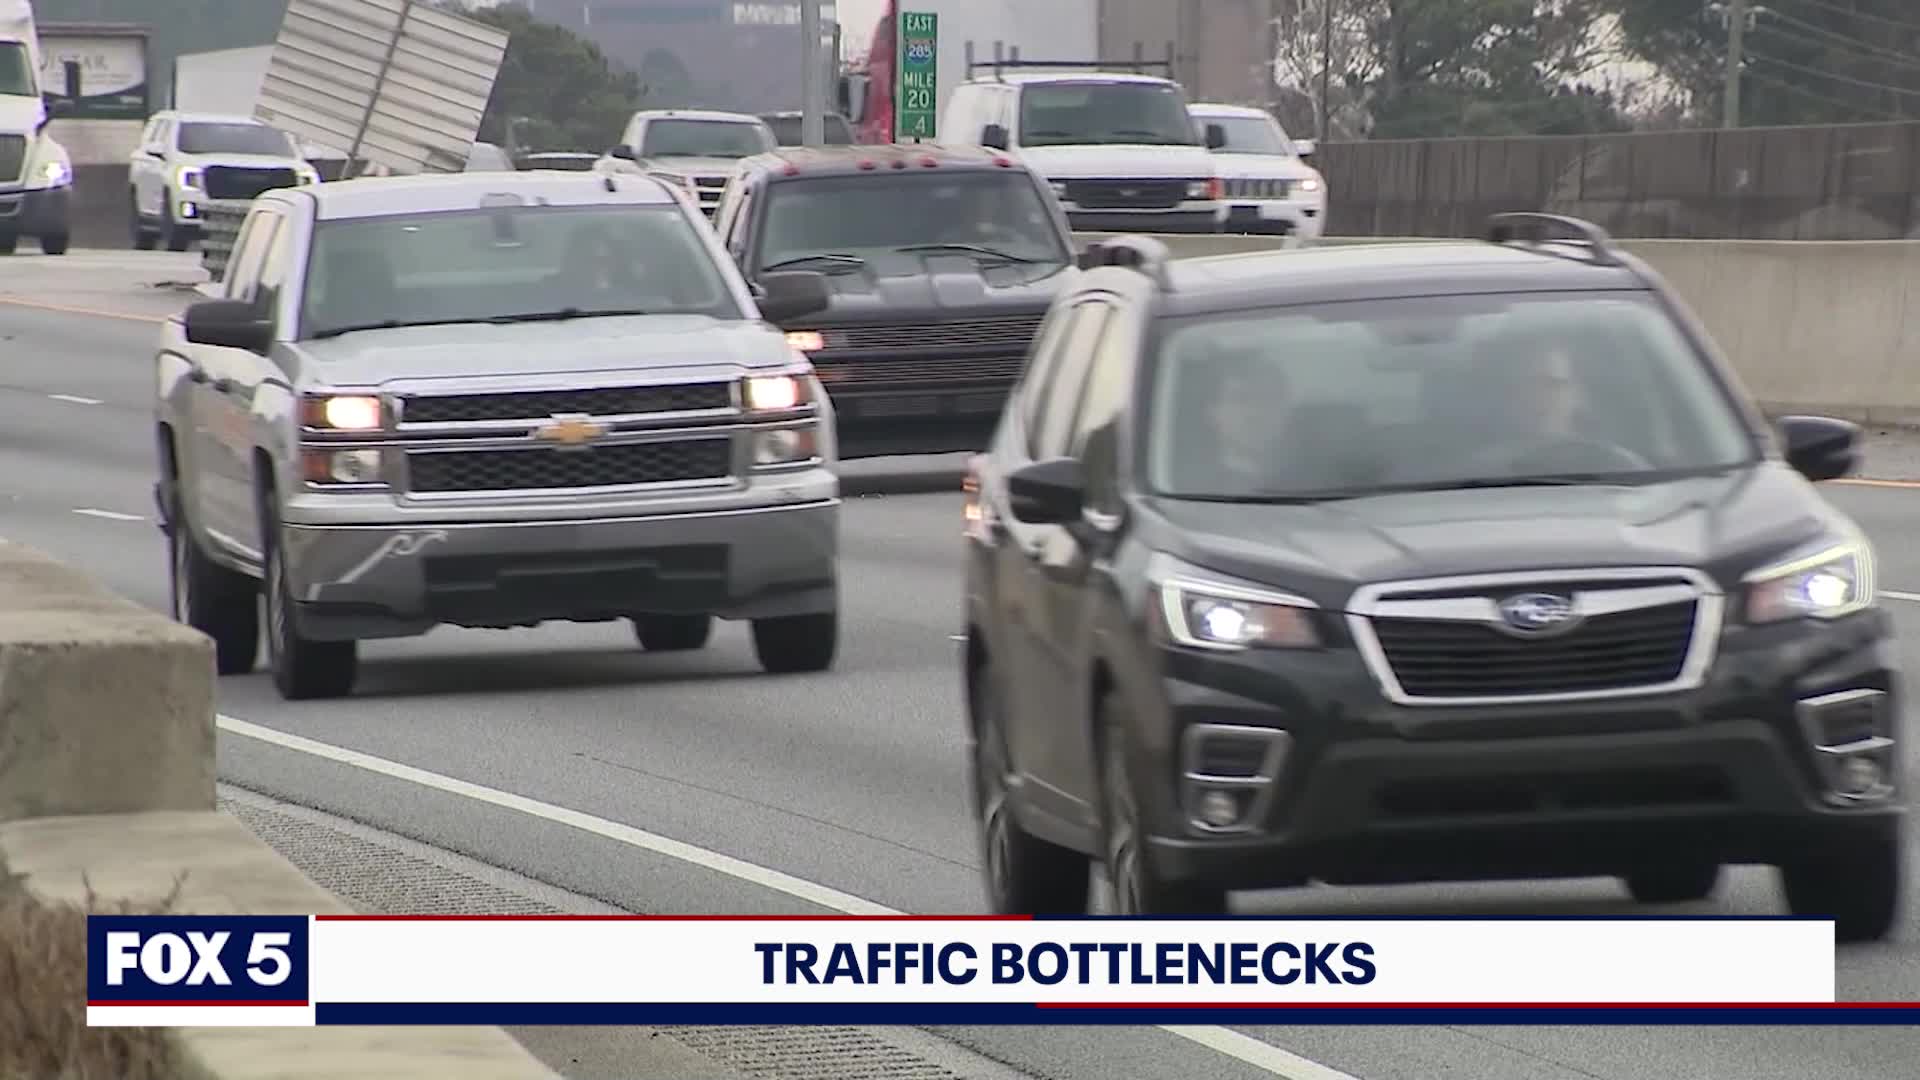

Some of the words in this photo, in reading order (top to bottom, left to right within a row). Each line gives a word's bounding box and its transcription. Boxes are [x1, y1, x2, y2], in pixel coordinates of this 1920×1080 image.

[907, 15, 933, 32] EAST
[908, 44, 932, 58] 285
[904, 71, 934, 89] MILE
[908, 89, 930, 109] 20
